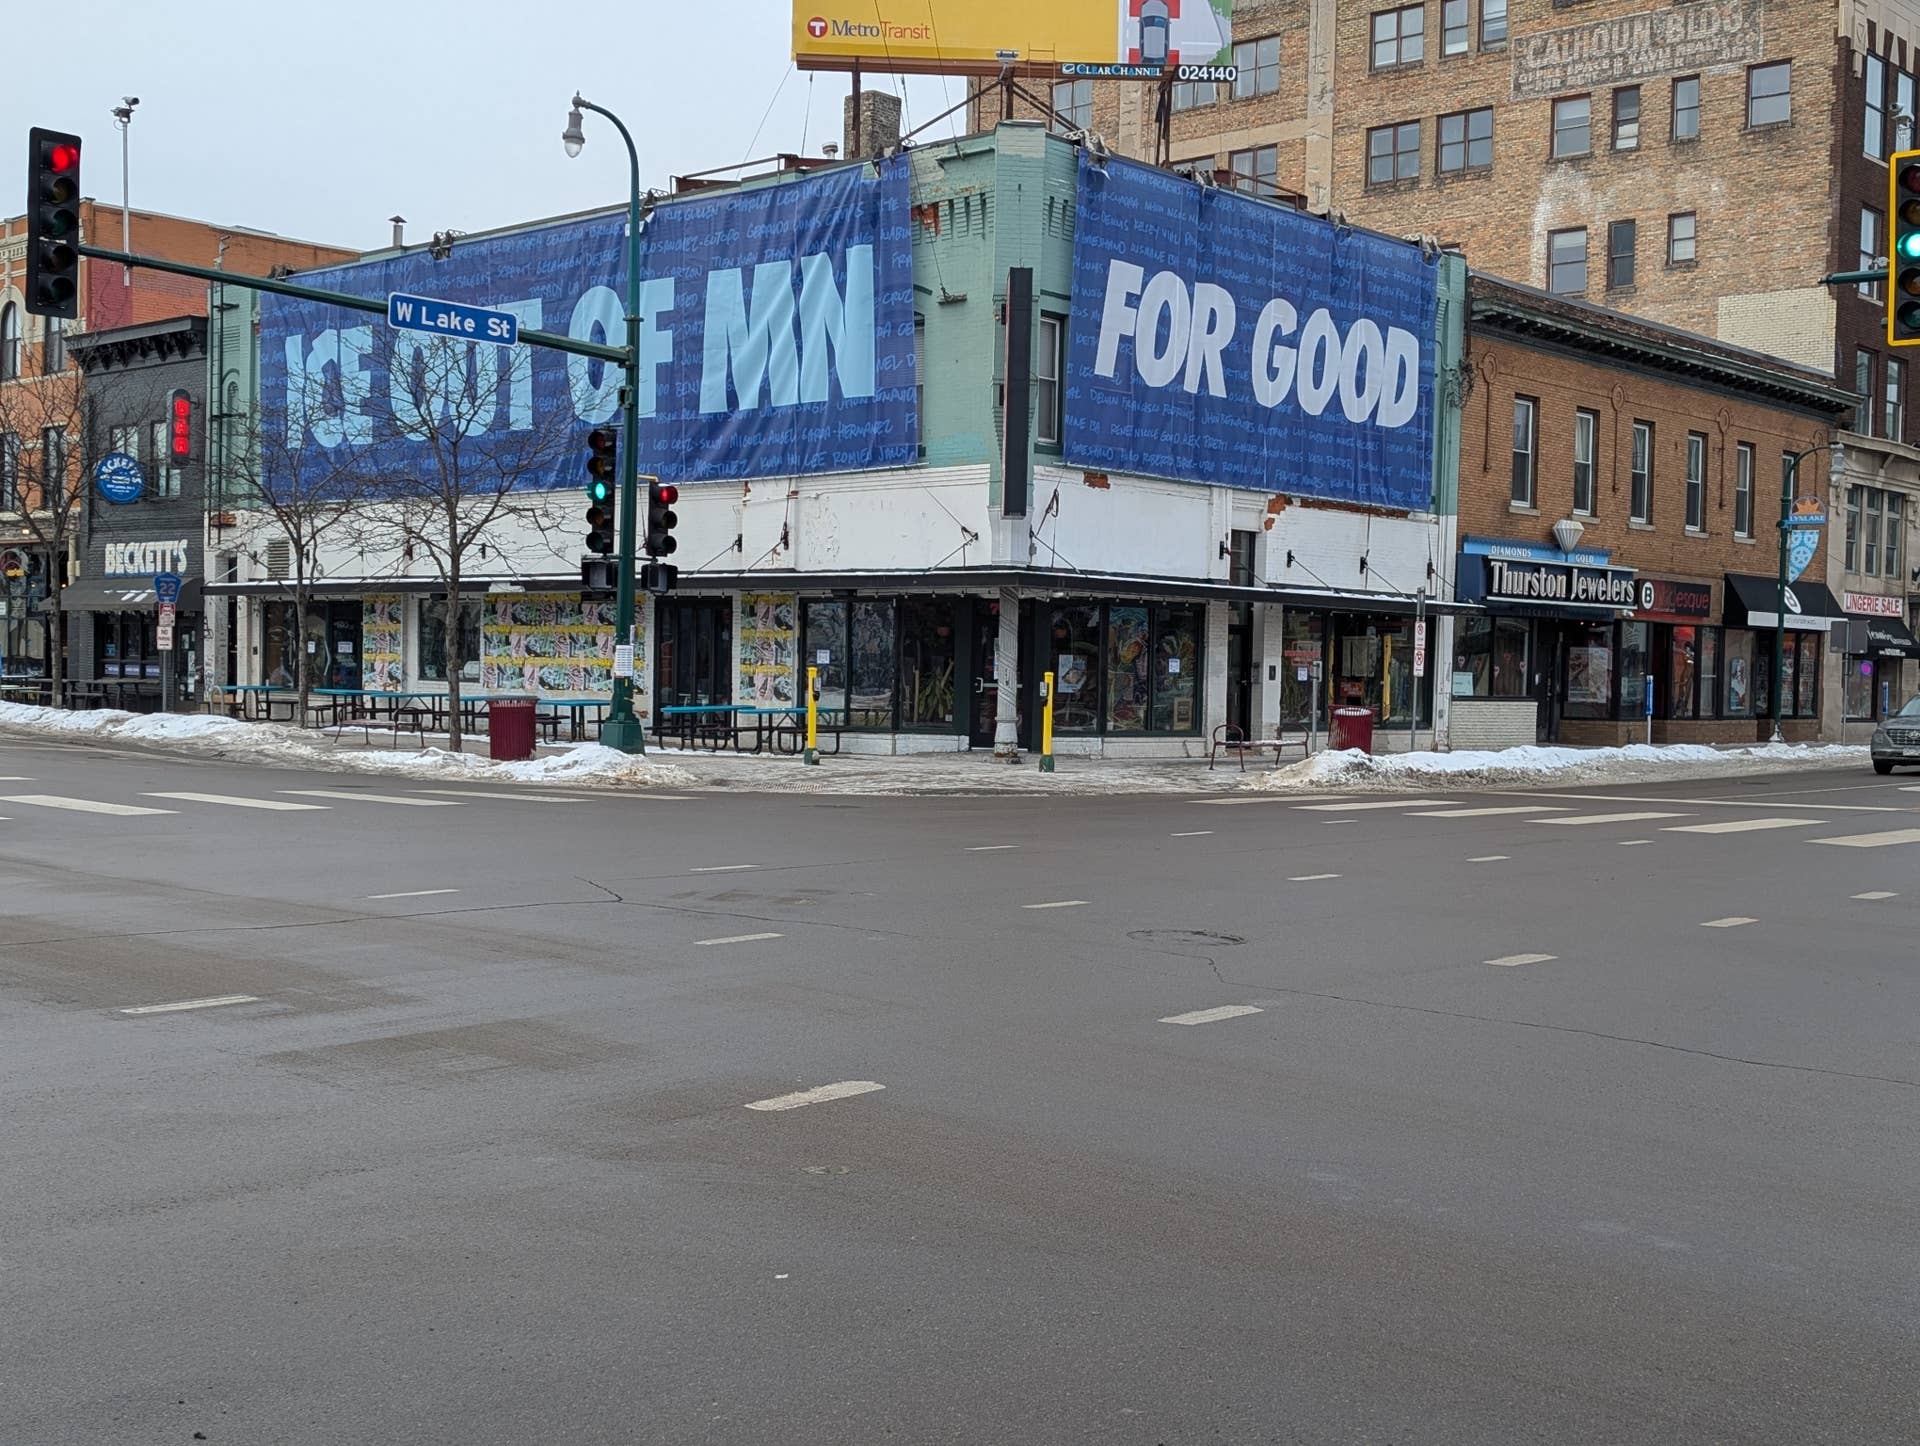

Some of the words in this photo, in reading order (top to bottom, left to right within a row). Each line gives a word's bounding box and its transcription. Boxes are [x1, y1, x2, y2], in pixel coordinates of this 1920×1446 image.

[1527, 17, 1652, 69] CALHOUN
[1178, 66, 1237, 81] 024140
[396, 301, 413, 322] W
[421, 306, 476, 332] Lake
[487, 317, 511, 338] St
[699, 243, 876, 414] MN
[1094, 258, 1236, 398] FOR
[1252, 297, 1419, 428] GOOD
[285, 325, 373, 450] ICE
[567, 277, 675, 425] OF
[104, 539, 188, 574] BECKETT'S
[1491, 546, 1532, 558] DIAMONDS
[160, 583, 176, 594] 22
[1490, 561, 1567, 598] Thurston
[1570, 568, 1635, 602] Jewelers
[1845, 594, 1880, 613] LINGERIE
[1881, 599, 1901, 614] SALE
